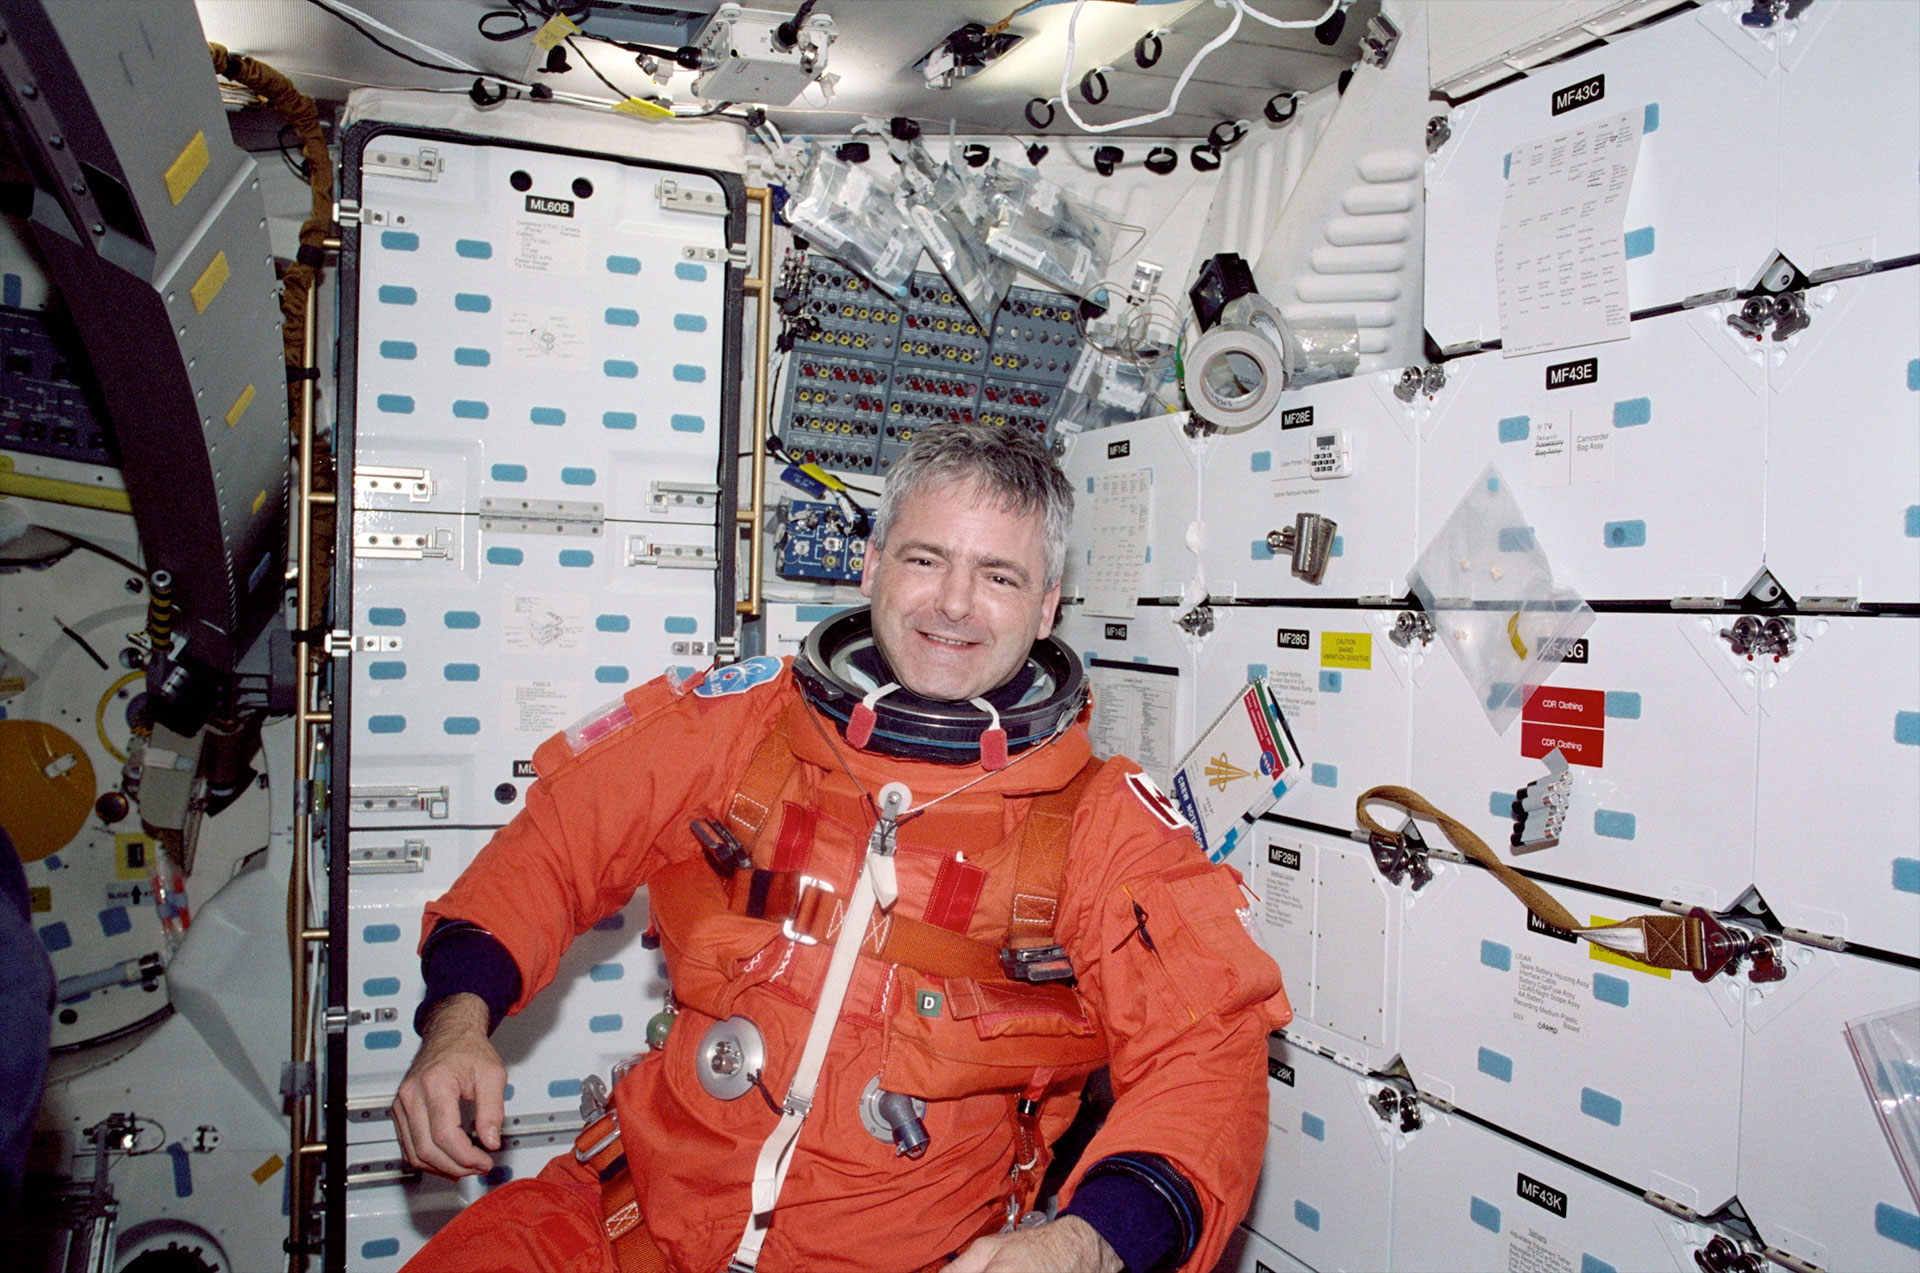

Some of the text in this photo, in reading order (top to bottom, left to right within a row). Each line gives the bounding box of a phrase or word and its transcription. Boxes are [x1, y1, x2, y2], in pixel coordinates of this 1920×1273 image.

[1556, 81, 1601, 110] MF43C
[530, 198, 570, 214] ML60B
[1550, 363, 1593, 385] MF43E
[1284, 410, 1311, 425] MF28E
[1576, 433, 1609, 442] Camcorder
[1577, 442, 1604, 452] Bag Assy
[1279, 632, 1307, 646] MF28G
[1542, 699, 1583, 712] CDR Clothing
[1541, 738, 1582, 752] CDR Clothing
[1178, 775, 1190, 801] CREW
[1186, 802, 1205, 849] NOTEBOOK
[1270, 848, 1298, 867] MF28H
[1515, 953, 1532, 963] LIDAR
[1554, 970, 1576, 985] Housing
[1576, 977, 1590, 989] Assy
[924, 996, 935, 1009] D
[1513, 998, 1538, 1013] Recording
[1521, 1179, 1562, 1211] MF43K
